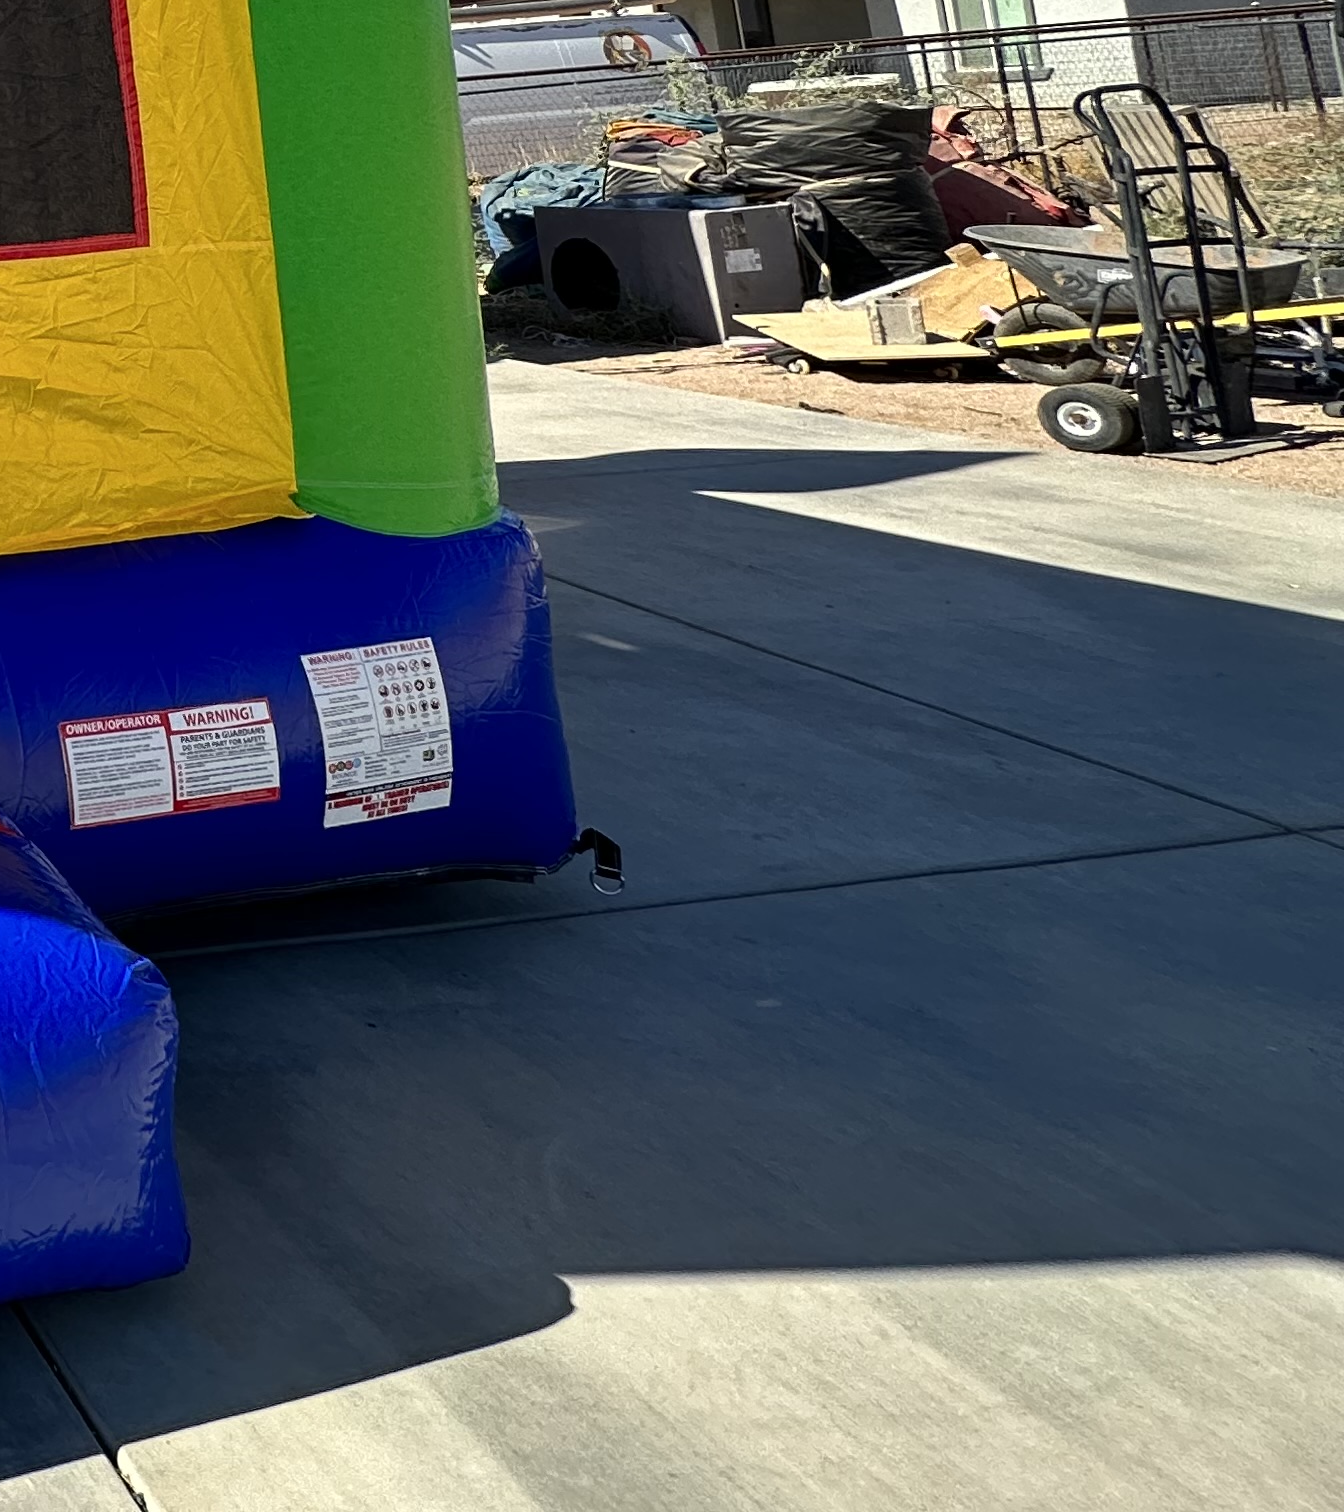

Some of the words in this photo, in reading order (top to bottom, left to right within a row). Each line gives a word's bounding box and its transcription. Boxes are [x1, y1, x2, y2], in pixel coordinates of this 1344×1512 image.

[363, 647, 398, 658] SAFETY
[400, 640, 430, 652] RULES
[66, 714, 161, 735] OWNER/OPERATOR
[182, 705, 254, 727] WARNING!
[180, 733, 213, 743] PARENTS
[221, 726, 265, 738] GUARDIANS
[243, 735, 265, 744] SAFETY
